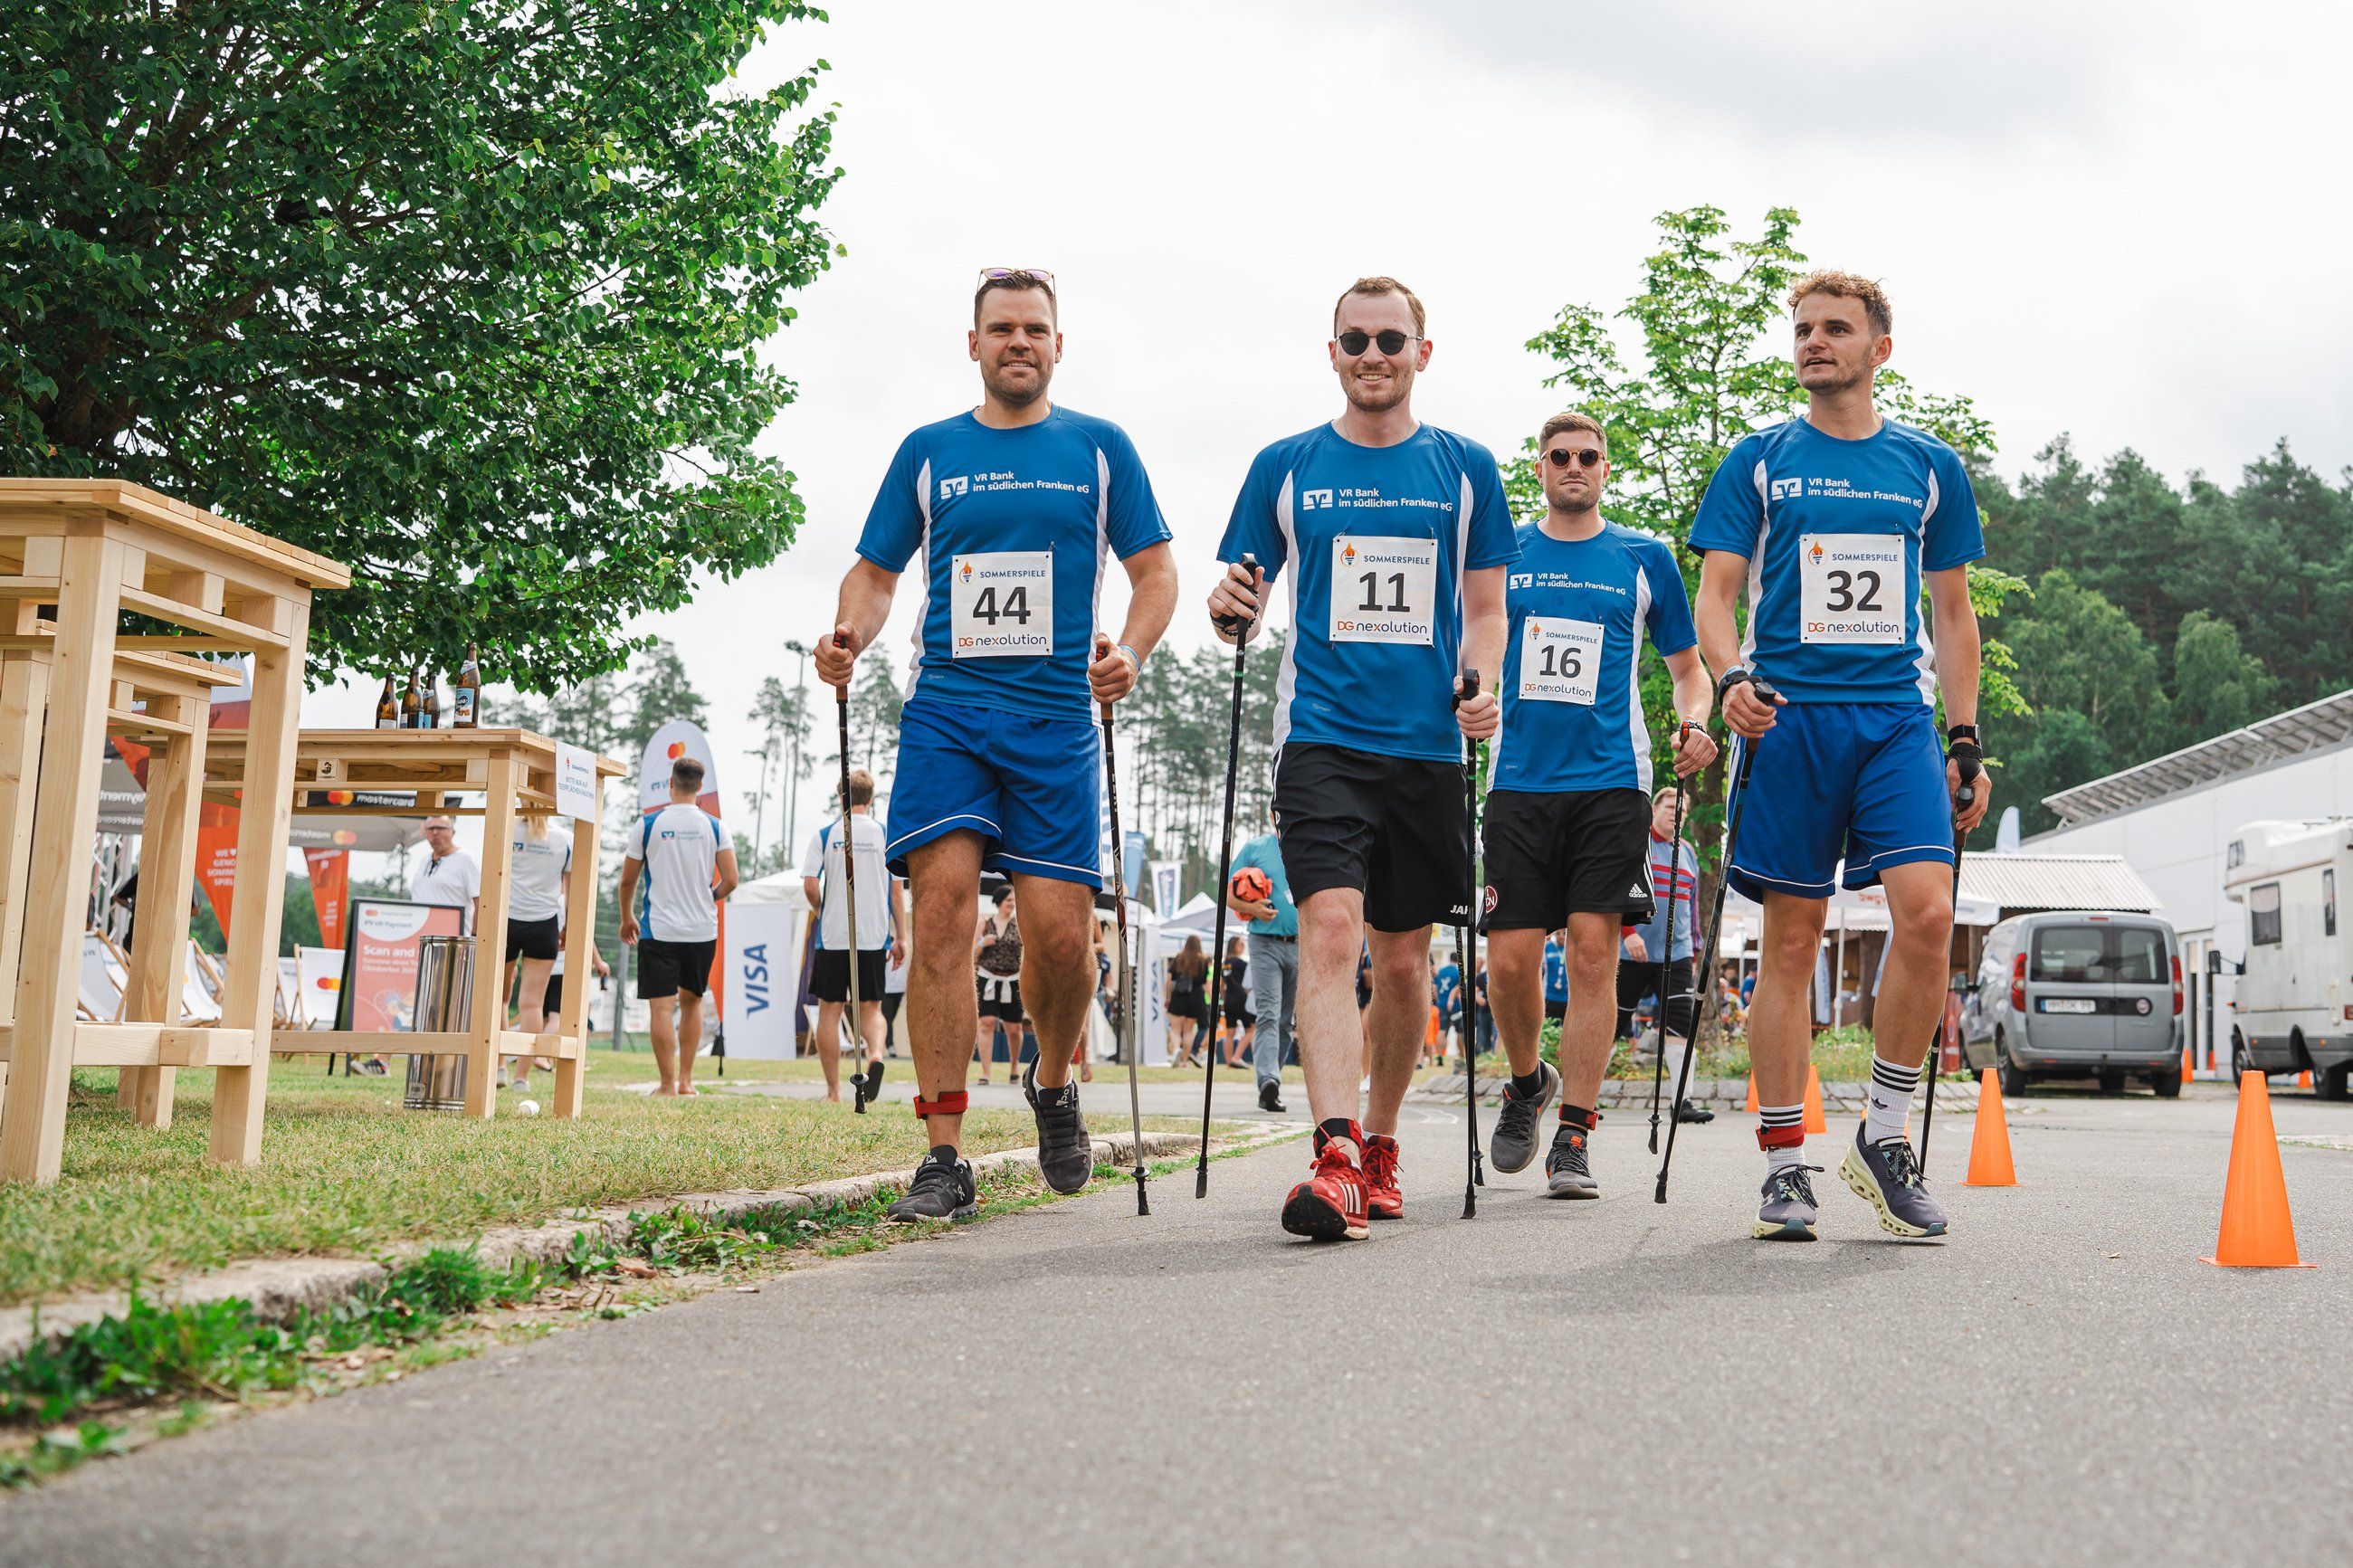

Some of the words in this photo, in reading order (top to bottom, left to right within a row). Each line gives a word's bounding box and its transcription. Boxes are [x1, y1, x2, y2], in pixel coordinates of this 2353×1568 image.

[975, 473, 987, 482] VR
[990, 470, 1015, 480] Bank
[973, 483, 986, 492] im
[987, 480, 1034, 491] südlichen
[1036, 480, 1074, 491] Franken
[1077, 484, 1090, 494] eG
[1808, 478, 1823, 486] VR
[1825, 478, 1850, 488] Bank
[1338, 489, 1353, 497] VR
[1356, 488, 1379, 497] Bank
[1807, 487, 1820, 496] im
[1823, 487, 1872, 499] südlichen
[1873, 490, 1911, 505] Franken
[1912, 499, 1923, 508] eG
[1338, 499, 1350, 508] im
[1353, 498, 1398, 508] südlichen
[1400, 499, 1438, 508] Franken
[1440, 502, 1453, 512] eG
[1364, 555, 1430, 565] SOMMERSPIELE
[1832, 553, 1899, 562] SOMMERSPIELE
[980, 570, 1046, 579] SOMMERSPIELE
[1549, 572, 1568, 580] Bank
[1358, 571, 1411, 613] 11
[1547, 580, 1583, 588] südlichen
[1585, 582, 1615, 593] Franken
[1615, 587, 1626, 595] eG
[1826, 570, 1882, 612] 32
[973, 586, 1031, 625] 44
[1337, 621, 1354, 631] DG
[1357, 621, 1427, 634] nexolution
[1808, 622, 1824, 632] DG
[1827, 621, 1899, 633] nexolution
[958, 637, 974, 647] DG
[976, 634, 1047, 646] nexolution
[1546, 632, 1598, 644] SOMMERSPIELE
[1539, 644, 1581, 679] 16
[1525, 683, 1536, 691] DG
[1538, 683, 1592, 698] nexolution
[357, 794, 415, 807] mastercard
[363, 945, 390, 956] Scan
[393, 946, 414, 958] and
[743, 943, 769, 1020] VISA
